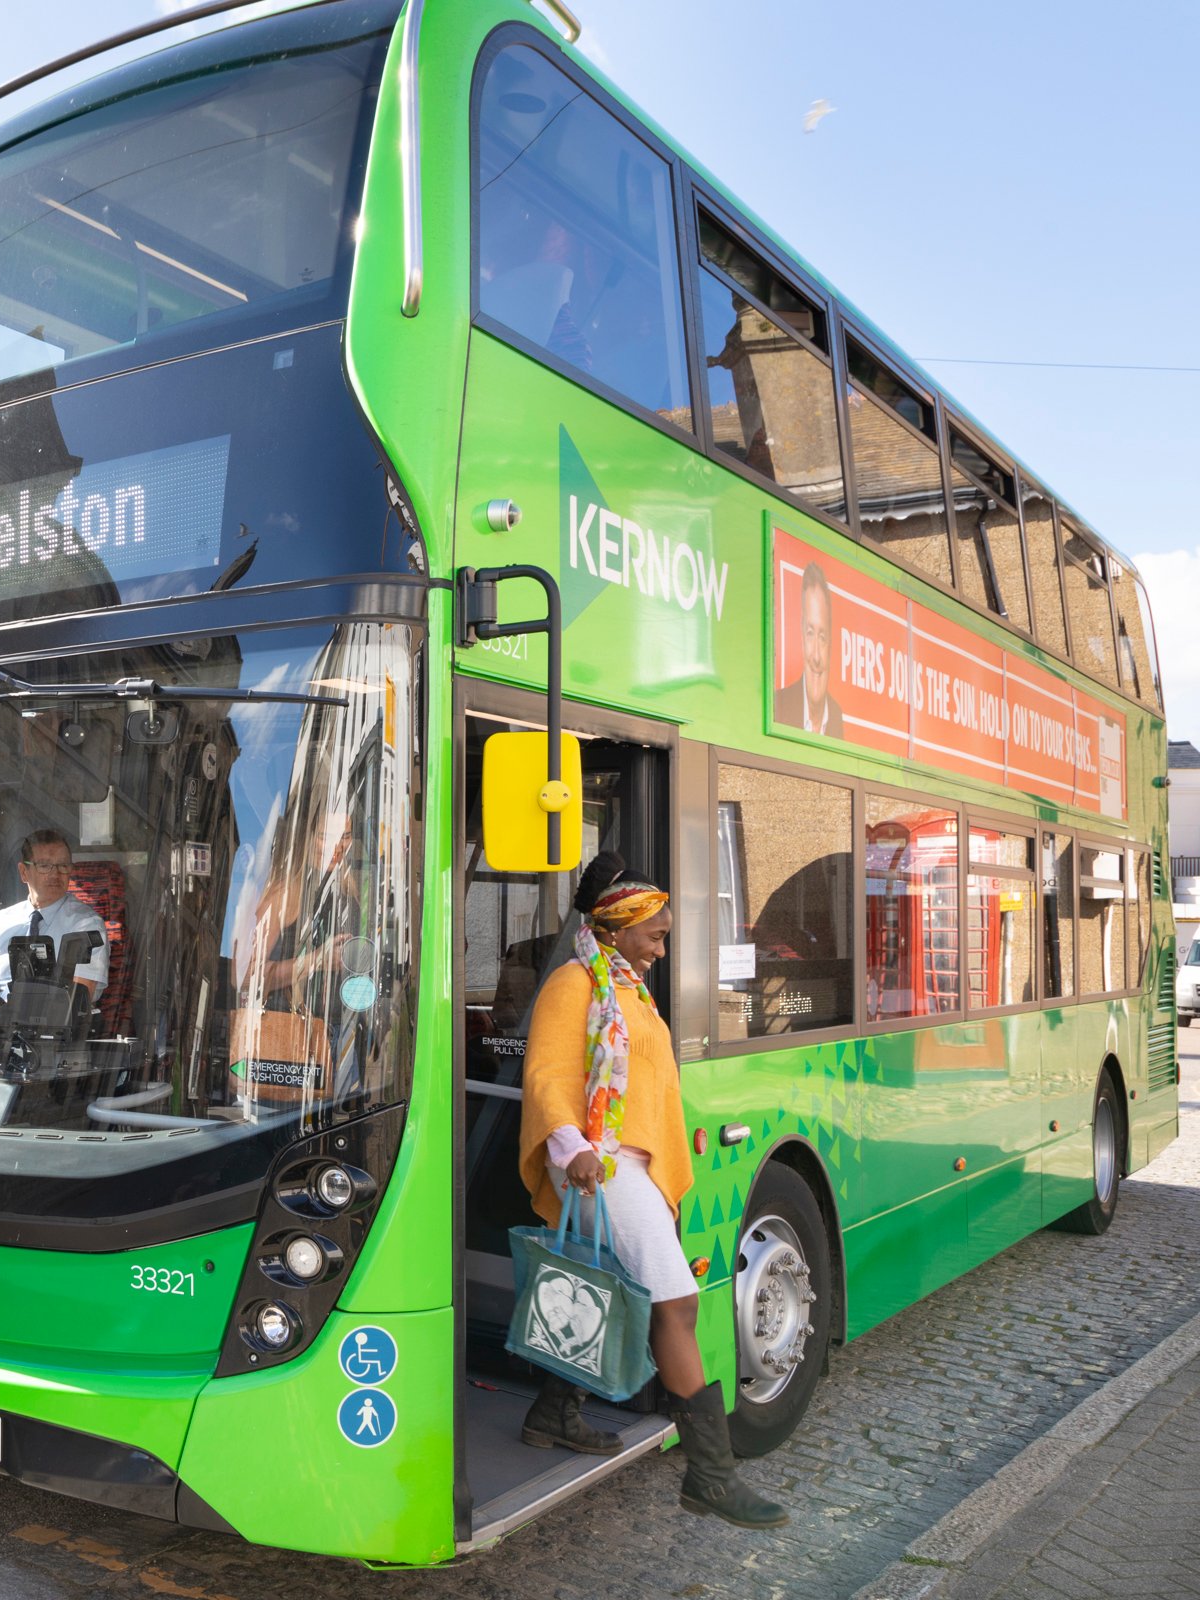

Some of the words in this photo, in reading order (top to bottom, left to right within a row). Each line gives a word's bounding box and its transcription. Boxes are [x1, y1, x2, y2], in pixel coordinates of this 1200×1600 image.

[570, 494, 729, 622] KERNOW
[841, 626, 885, 695] PIERS
[926, 666, 950, 721] THE
[953, 677, 978, 731] SUN.
[980, 689, 1011, 741] HOLD
[1013, 702, 1028, 749] ON
[1029, 709, 1041, 753] TO
[1041, 714, 1064, 762] YOUR
[482, 1036, 528, 1048] EMERGENC
[493, 1046, 513, 1055] PULL
[514, 1047, 526, 1056] TO
[249, 1061, 302, 1075] EMERGENCY
[302, 1066, 321, 1077] EXIT
[249, 1071, 272, 1082] PUSH
[272, 1073, 285, 1083] TO
[285, 1075, 311, 1087] OPEN
[130, 1265, 195, 1296] 33321
